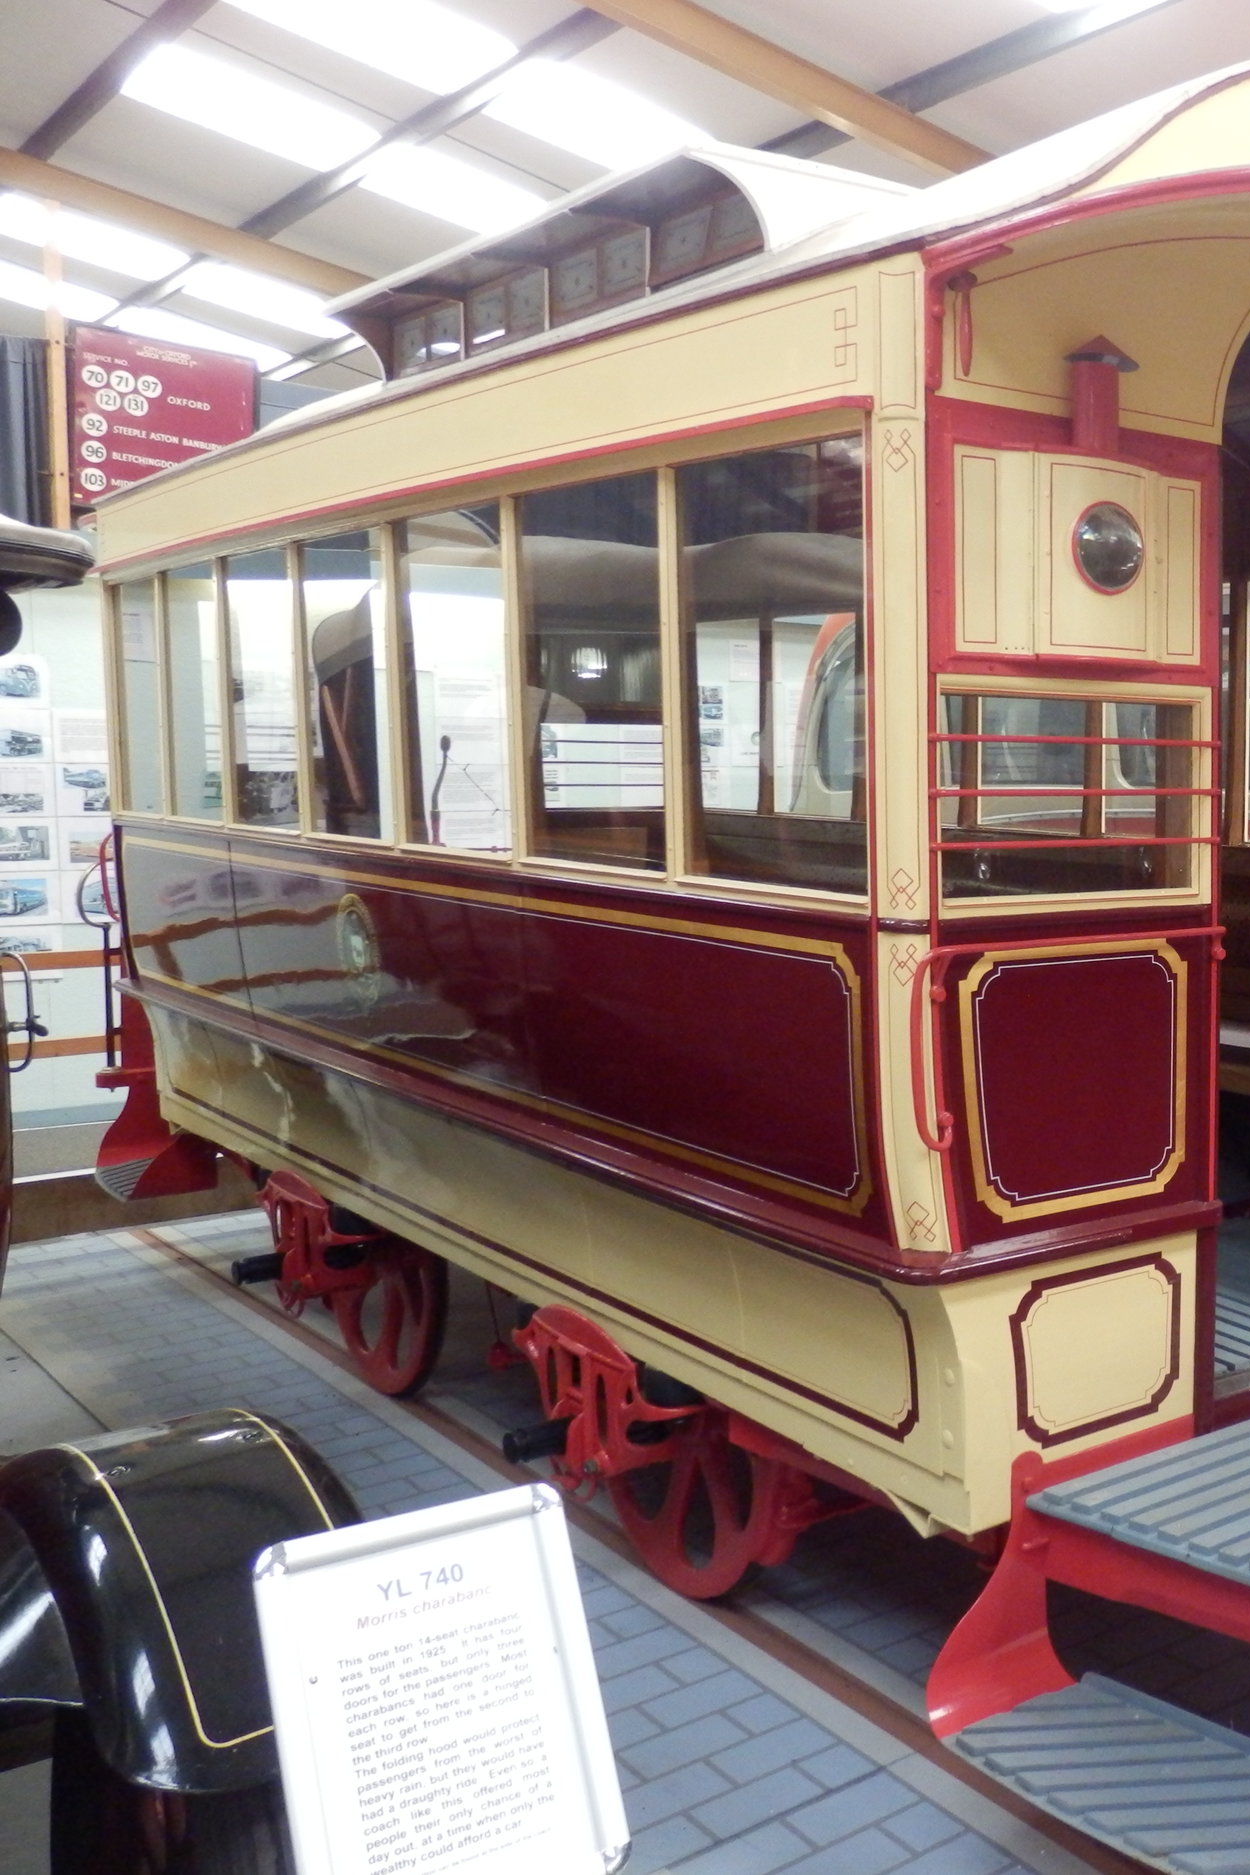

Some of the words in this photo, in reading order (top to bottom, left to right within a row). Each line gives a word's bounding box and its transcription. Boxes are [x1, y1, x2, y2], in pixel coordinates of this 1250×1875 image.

[82, 351, 112, 364] SERVICE
[86, 369, 105, 384] 70
[115, 374, 129, 388] 71
[141, 379, 159, 393] 97
[99, 393, 117, 407] 121
[128, 397, 144, 412] 131
[167, 395, 211, 412] OXFORD
[86, 418, 104, 433] 92
[112, 425, 148, 440] STEEPLE
[149, 432, 180, 445] ASTON
[84, 473, 105, 487] 103
[85, 444, 105, 459] 96
[112, 452, 180, 470] BLETCHINGDO
[376, 1578, 412, 1602] YL
[419, 1563, 465, 1590] 740
[356, 1607, 408, 1631] Morris
[336, 1656, 364, 1670] This
[366, 1648, 391, 1663] one
[393, 1642, 414, 1655] ton
[338, 1670, 364, 1684] was
[368, 1659, 397, 1676] built
[401, 1655, 414, 1666] in
[473, 1632, 495, 1644] has
[341, 1682, 372, 1697] rows
[378, 1673, 392, 1687] of
[439, 1654, 460, 1669] but
[465, 1646, 490, 1661] only
[496, 1637, 525, 1651] three
[342, 1694, 380, 1712] doors
[381, 1687, 399, 1700] for
[401, 1681, 422, 1694] the
[499, 1648, 528, 1664] Most
[344, 1697, 416, 1726] charabancs
[422, 1686, 446, 1701] had
[451, 1679, 474, 1693] one
[480, 1668, 508, 1684] door
[513, 1662, 530, 1672] for
[347, 1722, 378, 1739] each
[414, 1706, 431, 1719] so
[434, 1697, 461, 1712] here
[465, 1692, 478, 1702] is
[349, 1736, 377, 1753] seat
[379, 1732, 395, 1743] to
[398, 1723, 418, 1740] get
[421, 1714, 451, 1730] from
[454, 1708, 474, 1720] the
[477, 1691, 520, 1713] second
[522, 1688, 536, 1698] to
[351, 1753, 372, 1767] the
[373, 1741, 404, 1760] third
[353, 1766, 378, 1779] The
[380, 1751, 425, 1772] folding
[427, 1738, 459, 1756] hood
[462, 1726, 498, 1746] would
[499, 1712, 541, 1736] protect
[356, 1764, 428, 1797] passengers
[433, 1753, 462, 1769] from
[467, 1745, 487, 1758] the
[493, 1731, 525, 1750] worst
[530, 1724, 543, 1737] of
[358, 1789, 396, 1809] heavy
[428, 1770, 450, 1786] but
[451, 1764, 477, 1778] they
[479, 1748, 516, 1768] would
[517, 1740, 546, 1755] have
[360, 1805, 385, 1823] had
[398, 1785, 453, 1810] draughty
[519, 1758, 535, 1770] so
[362, 1816, 402, 1837] coach
[409, 1806, 432, 1821] like
[440, 1796, 464, 1811] this
[471, 1778, 514, 1800] offered
[521, 1765, 551, 1782] most
[365, 1830, 408, 1854] people
[413, 1817, 442, 1835] their
[447, 1806, 474, 1823] only
[479, 1790, 522, 1811] chance
[527, 1781, 540, 1795] of
[367, 1851, 391, 1866] day
[420, 1834, 434, 1848] at
[445, 1822, 473, 1838] time
[475, 1810, 507, 1828] when
[509, 1800, 534, 1816] only
[536, 1793, 555, 1806] the
[419, 1841, 455, 1862] could
[456, 1828, 492, 1850] afford
